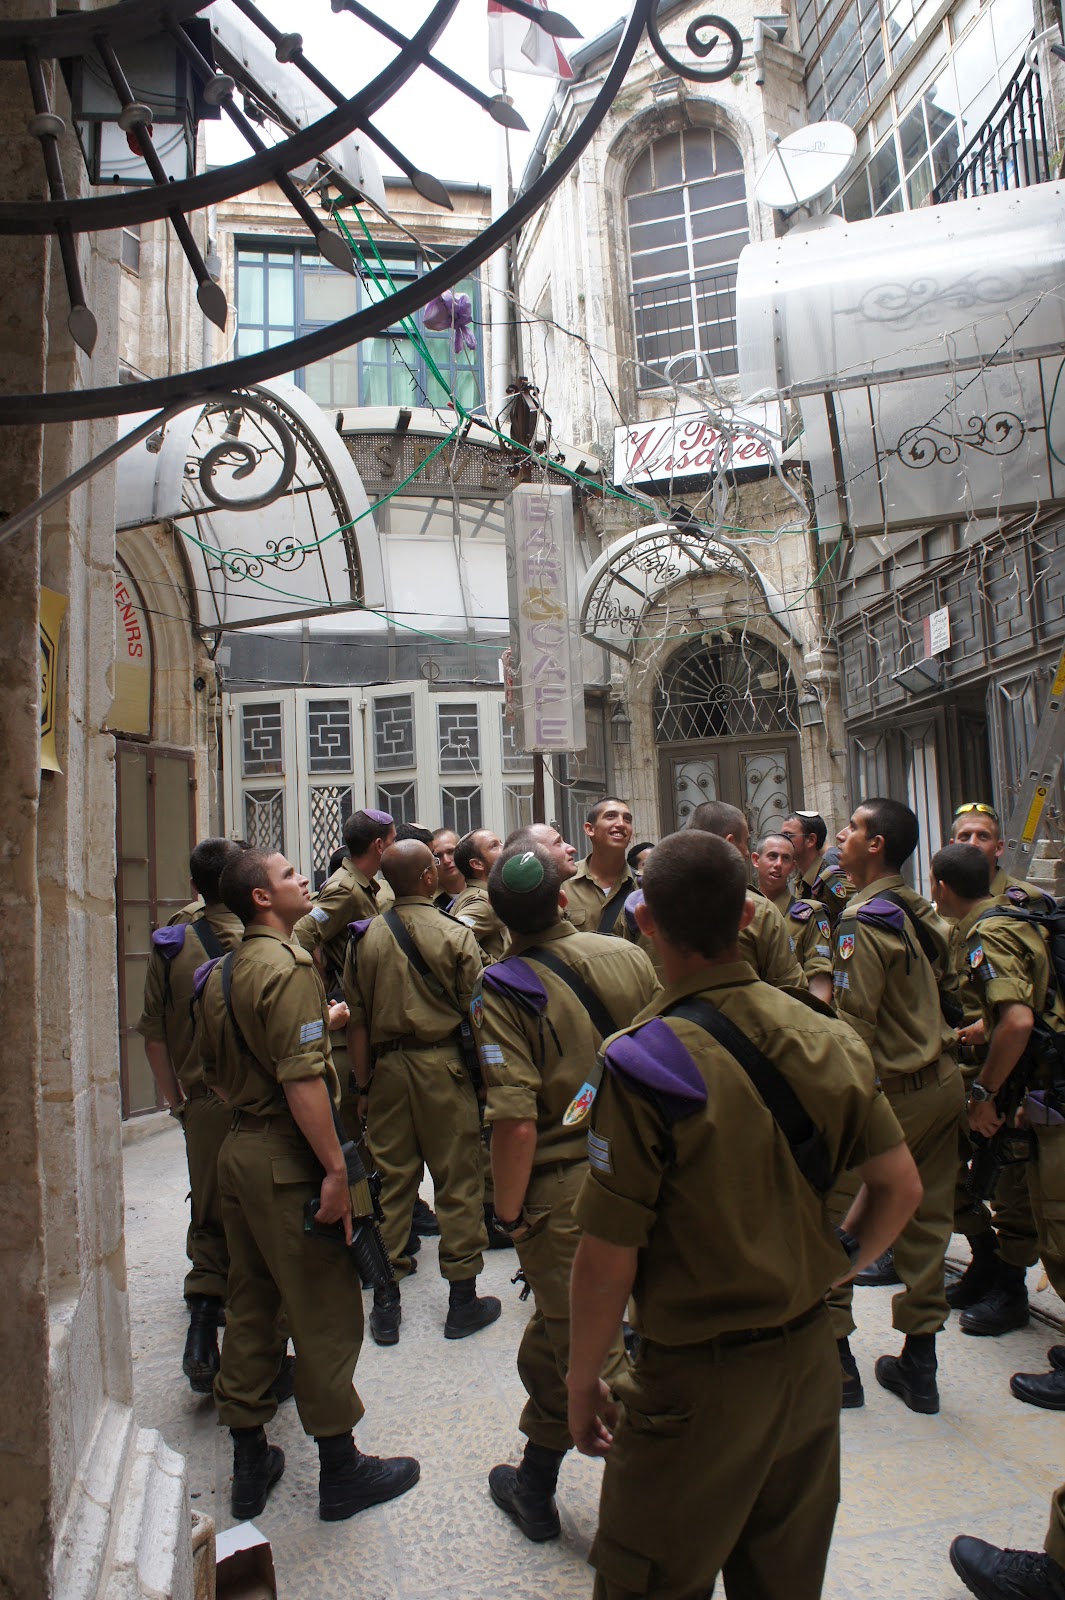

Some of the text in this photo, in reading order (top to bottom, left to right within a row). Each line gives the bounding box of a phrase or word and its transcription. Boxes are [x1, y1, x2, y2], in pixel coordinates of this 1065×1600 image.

[520, 494, 561, 584] BAR
[114, 581, 143, 658] ENIRS
[527, 622, 568, 746] CAFE
